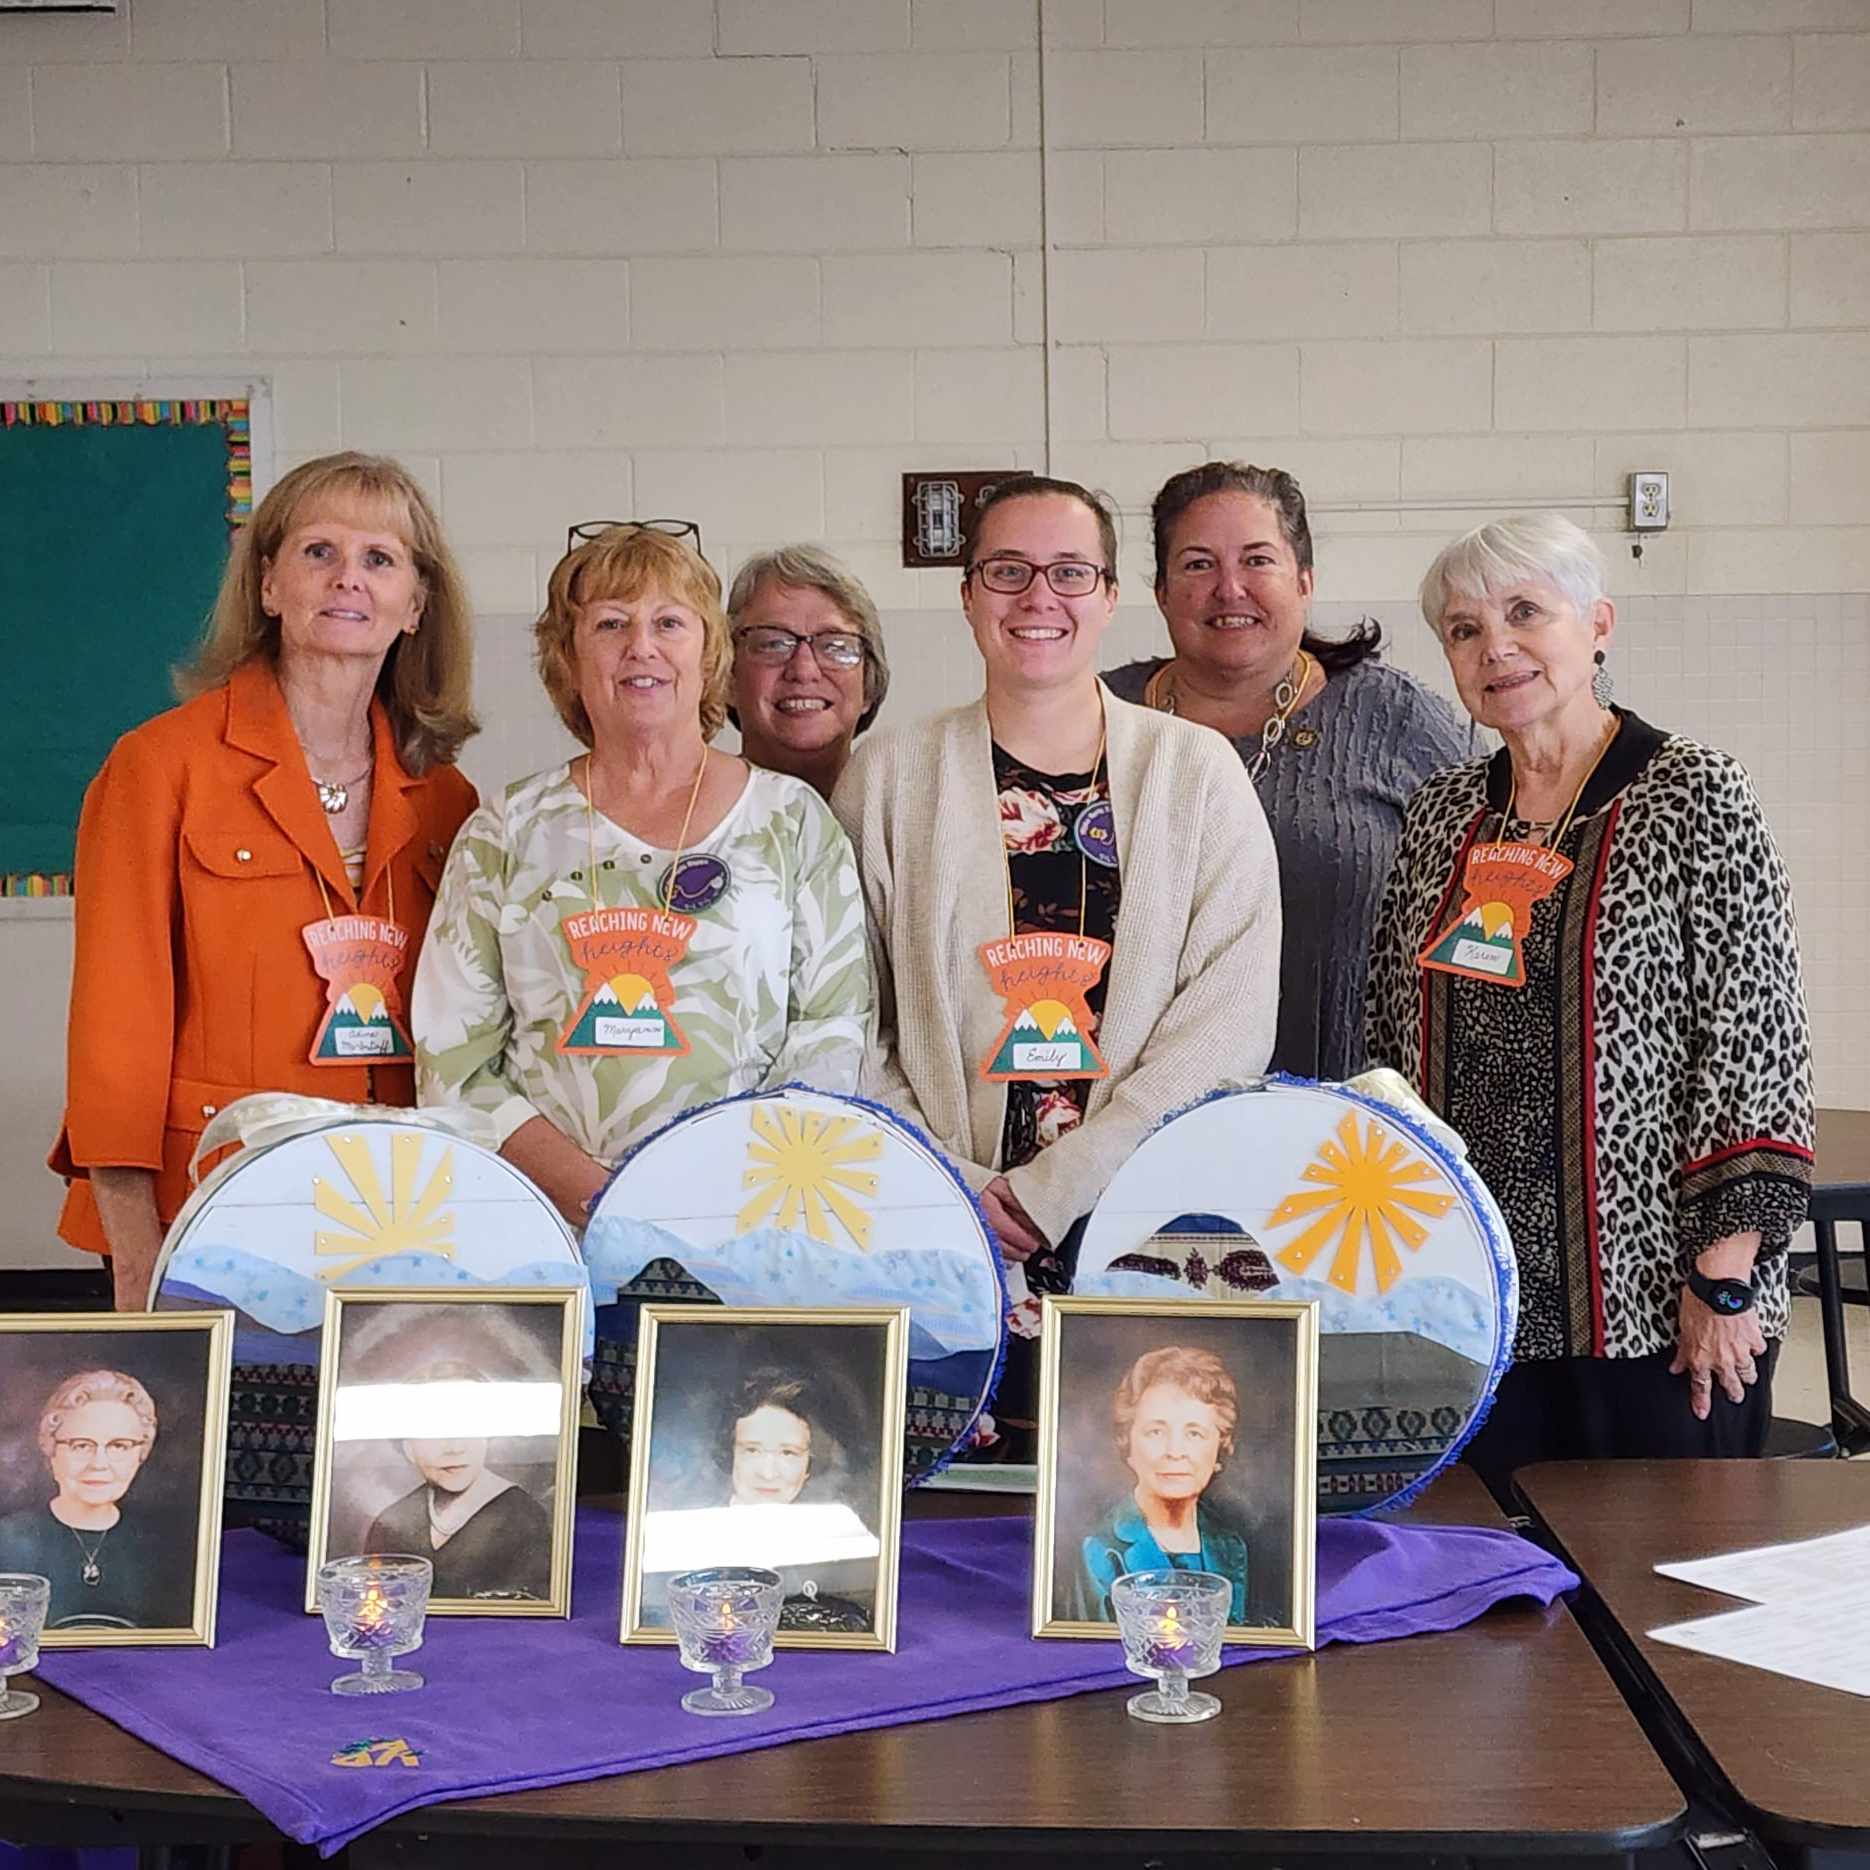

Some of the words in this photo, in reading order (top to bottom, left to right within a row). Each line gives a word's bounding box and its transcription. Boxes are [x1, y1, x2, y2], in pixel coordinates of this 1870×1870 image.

[1472, 847, 1537, 866] REACHING
[307, 919, 377, 946] REACHING
[568, 911, 648, 940] REACHING
[651, 914, 693, 941] NEW
[986, 937, 1063, 968] REACHING
[1067, 939, 1107, 967] NEW
[1025, 1047, 1068, 1067] Emily
